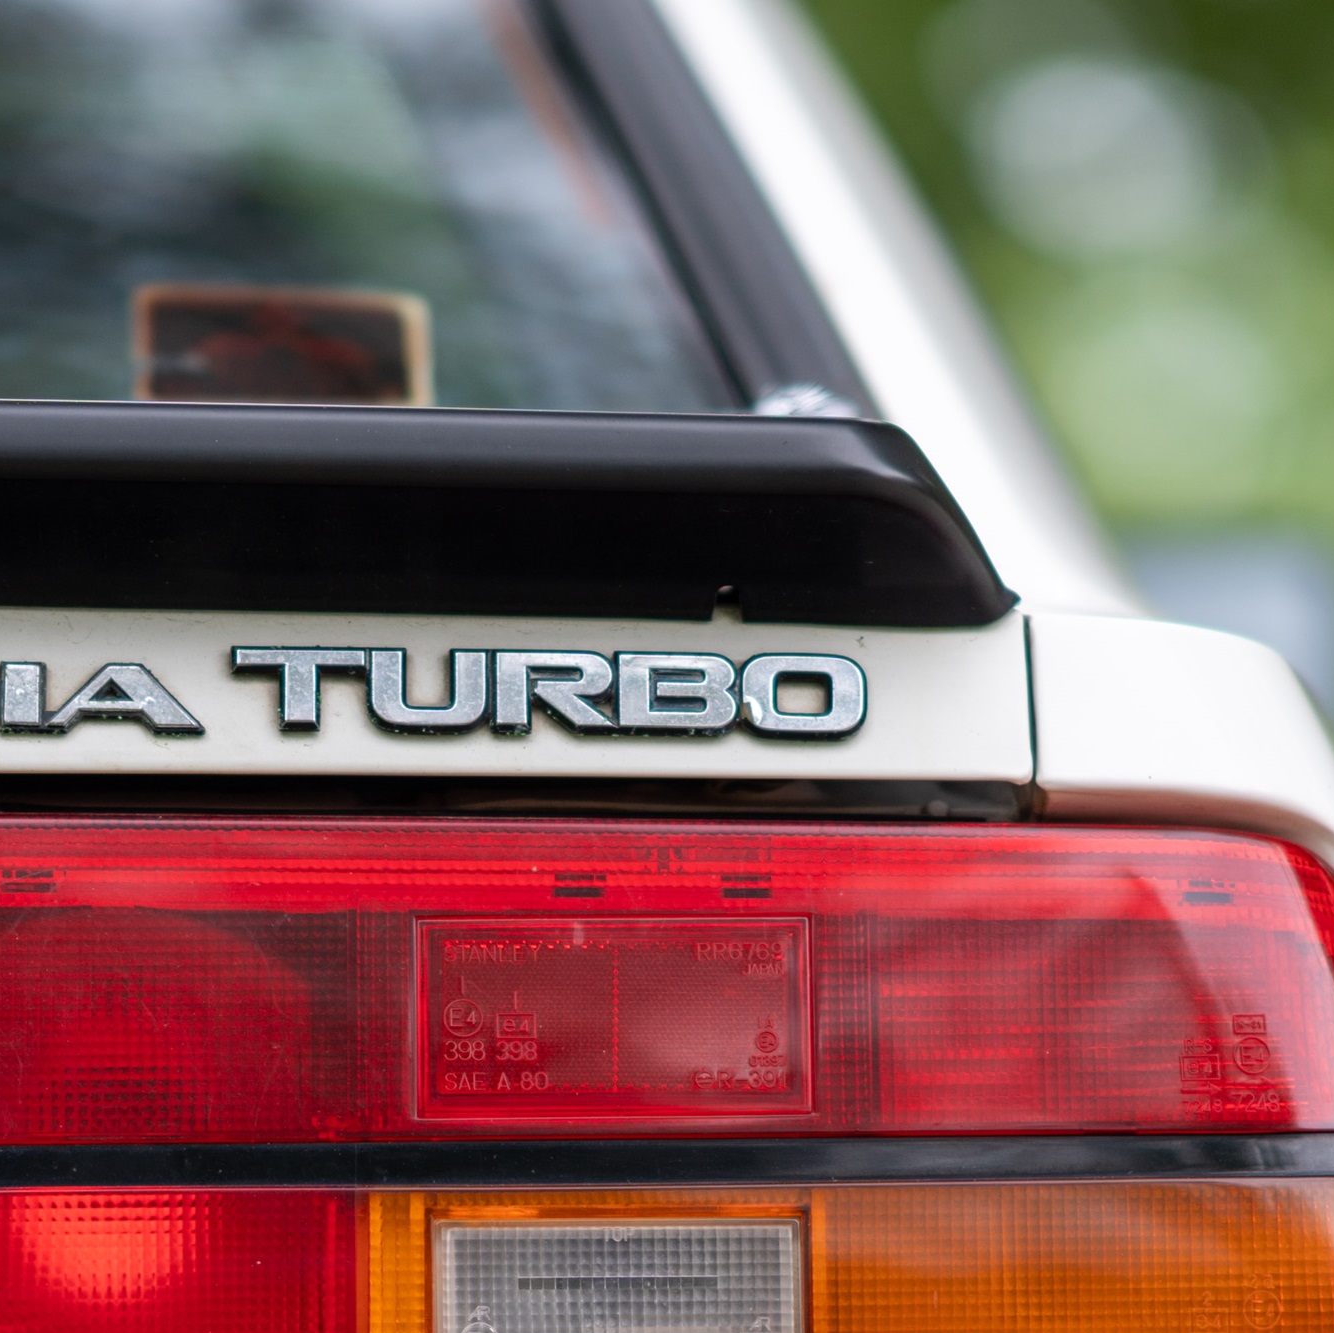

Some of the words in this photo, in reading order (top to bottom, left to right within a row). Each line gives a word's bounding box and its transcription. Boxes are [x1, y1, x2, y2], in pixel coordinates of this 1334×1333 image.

[231, 645, 870, 741] TURBO
[444, 943, 542, 963] STANLEY
[696, 942, 785, 962] RR6769
[742, 963, 786, 976] JAPAN
[443, 1040, 486, 1061] 398
[495, 1041, 538, 1061] 398
[444, 1072, 487, 1091] SAE
[497, 1072, 511, 1091] A
[520, 1071, 549, 1090] 80
[1230, 1092, 1280, 1113] 7248
[601, 1226, 635, 1242] TOP
